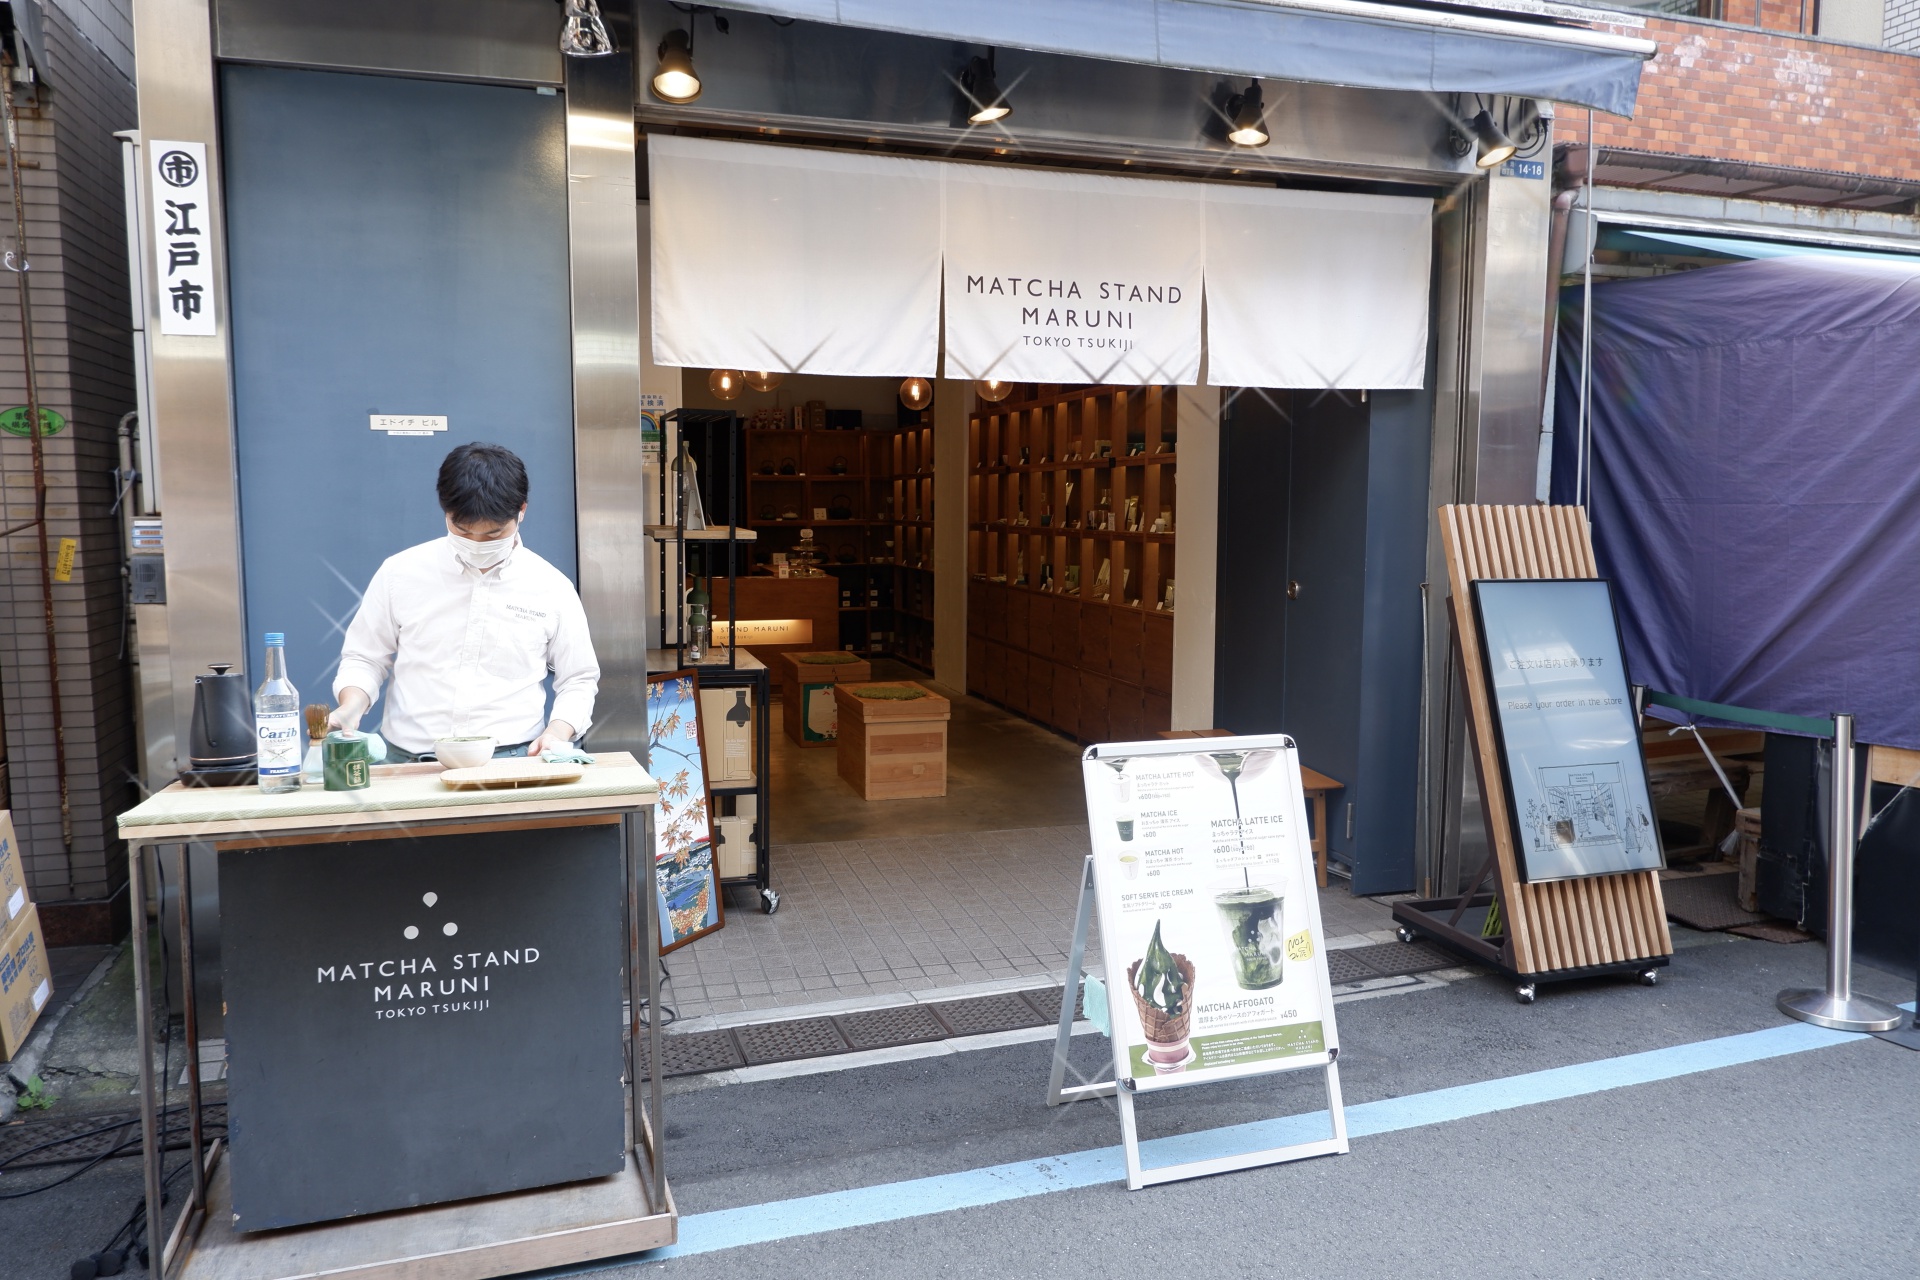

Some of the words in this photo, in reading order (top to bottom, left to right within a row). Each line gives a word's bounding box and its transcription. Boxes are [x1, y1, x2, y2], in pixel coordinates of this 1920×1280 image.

[1518, 164, 1542, 176] 14-18
[165, 200, 204, 320] 江戸市
[967, 275, 1082, 299] MATCHA
[1100, 282, 1182, 304] STAND
[1022, 307, 1132, 330] MARUNI
[1022, 335, 1070, 348] TOKYO
[1077, 337, 1133, 352] TSUKIJI
[529, 610, 547, 618] STAND
[1509, 656, 1604, 670] ご注文は店内で承ります
[1508, 701, 1532, 710] Please
[1536, 702, 1552, 710] your
[1556, 699, 1575, 708] order
[259, 726, 297, 738] Carib
[1211, 819, 1243, 828] MATCHA
[1245, 816, 1269, 826] LATTE
[1270, 815, 1283, 823] ICE
[1213, 845, 1230, 854] ¥600
[1139, 891, 1159, 899] SERVE
[317, 957, 436, 984] MATCHA
[453, 948, 540, 970] STAND
[374, 975, 489, 1002] MARUNI
[375, 1006, 427, 1020] TOKYO
[432, 1000, 489, 1014] TSUKIJI
[1197, 1002, 1231, 1013] MATCHA
[1233, 996, 1274, 1009] AFFOGATO
[1281, 1009, 1297, 1019] ¥450
